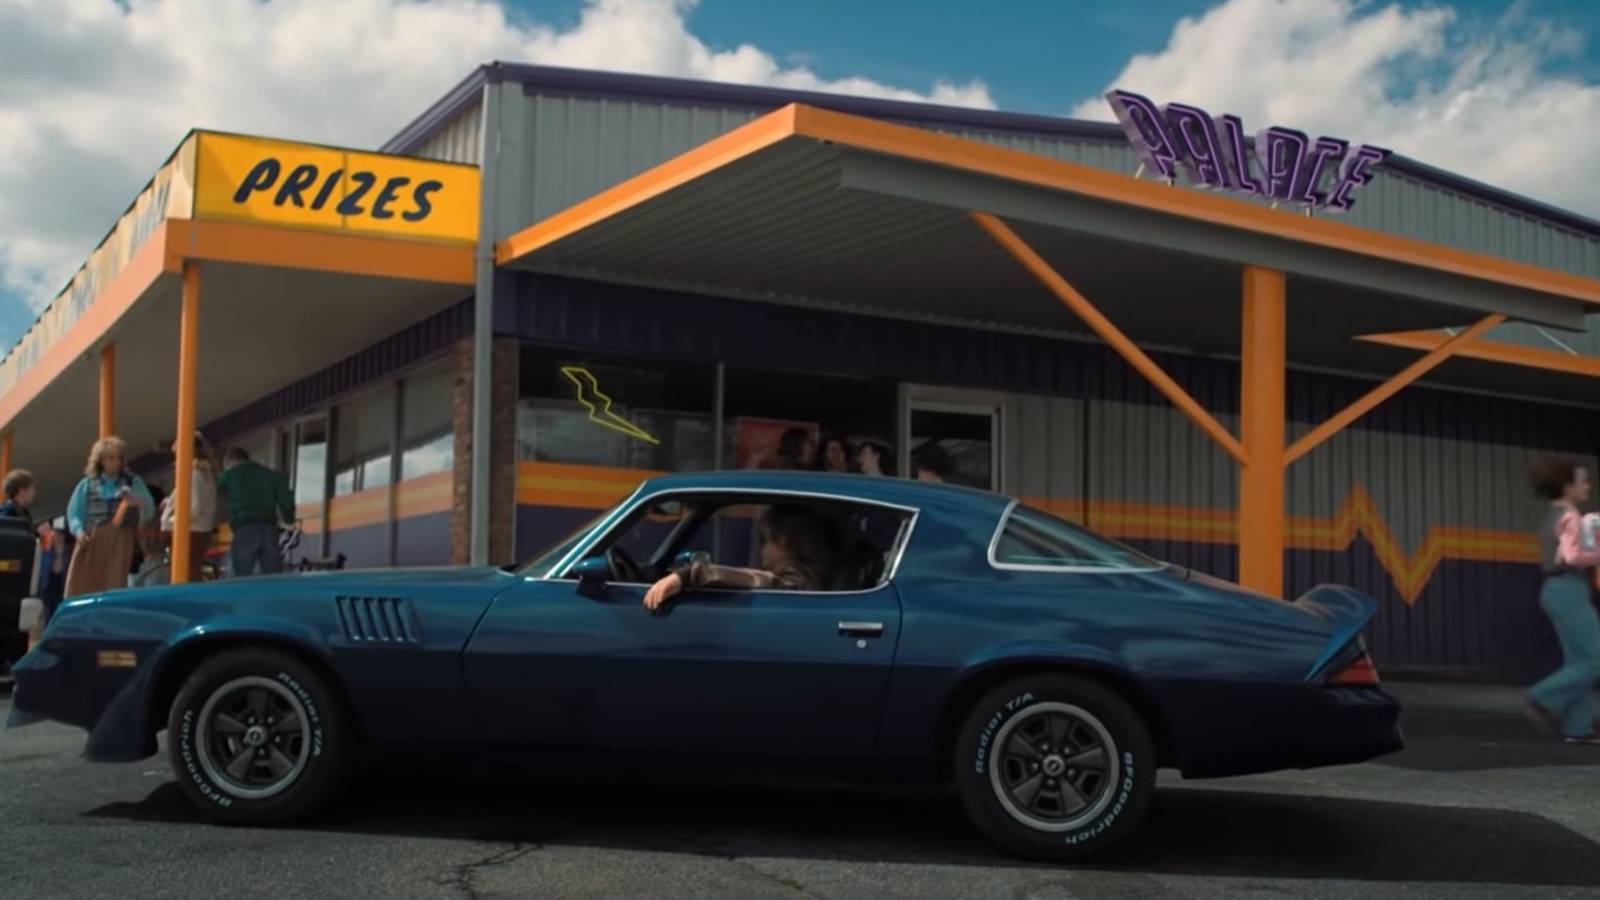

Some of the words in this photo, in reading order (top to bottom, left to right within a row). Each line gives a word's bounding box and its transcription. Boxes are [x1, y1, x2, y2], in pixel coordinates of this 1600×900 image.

[233, 158, 443, 221] PRIZES
[1105, 89, 1392, 212] PALACE
[278, 671, 319, 722] Radial
[312, 727, 322, 757] T/A
[975, 711, 1003, 774] Radial
[1005, 692, 1033, 711] T/A
